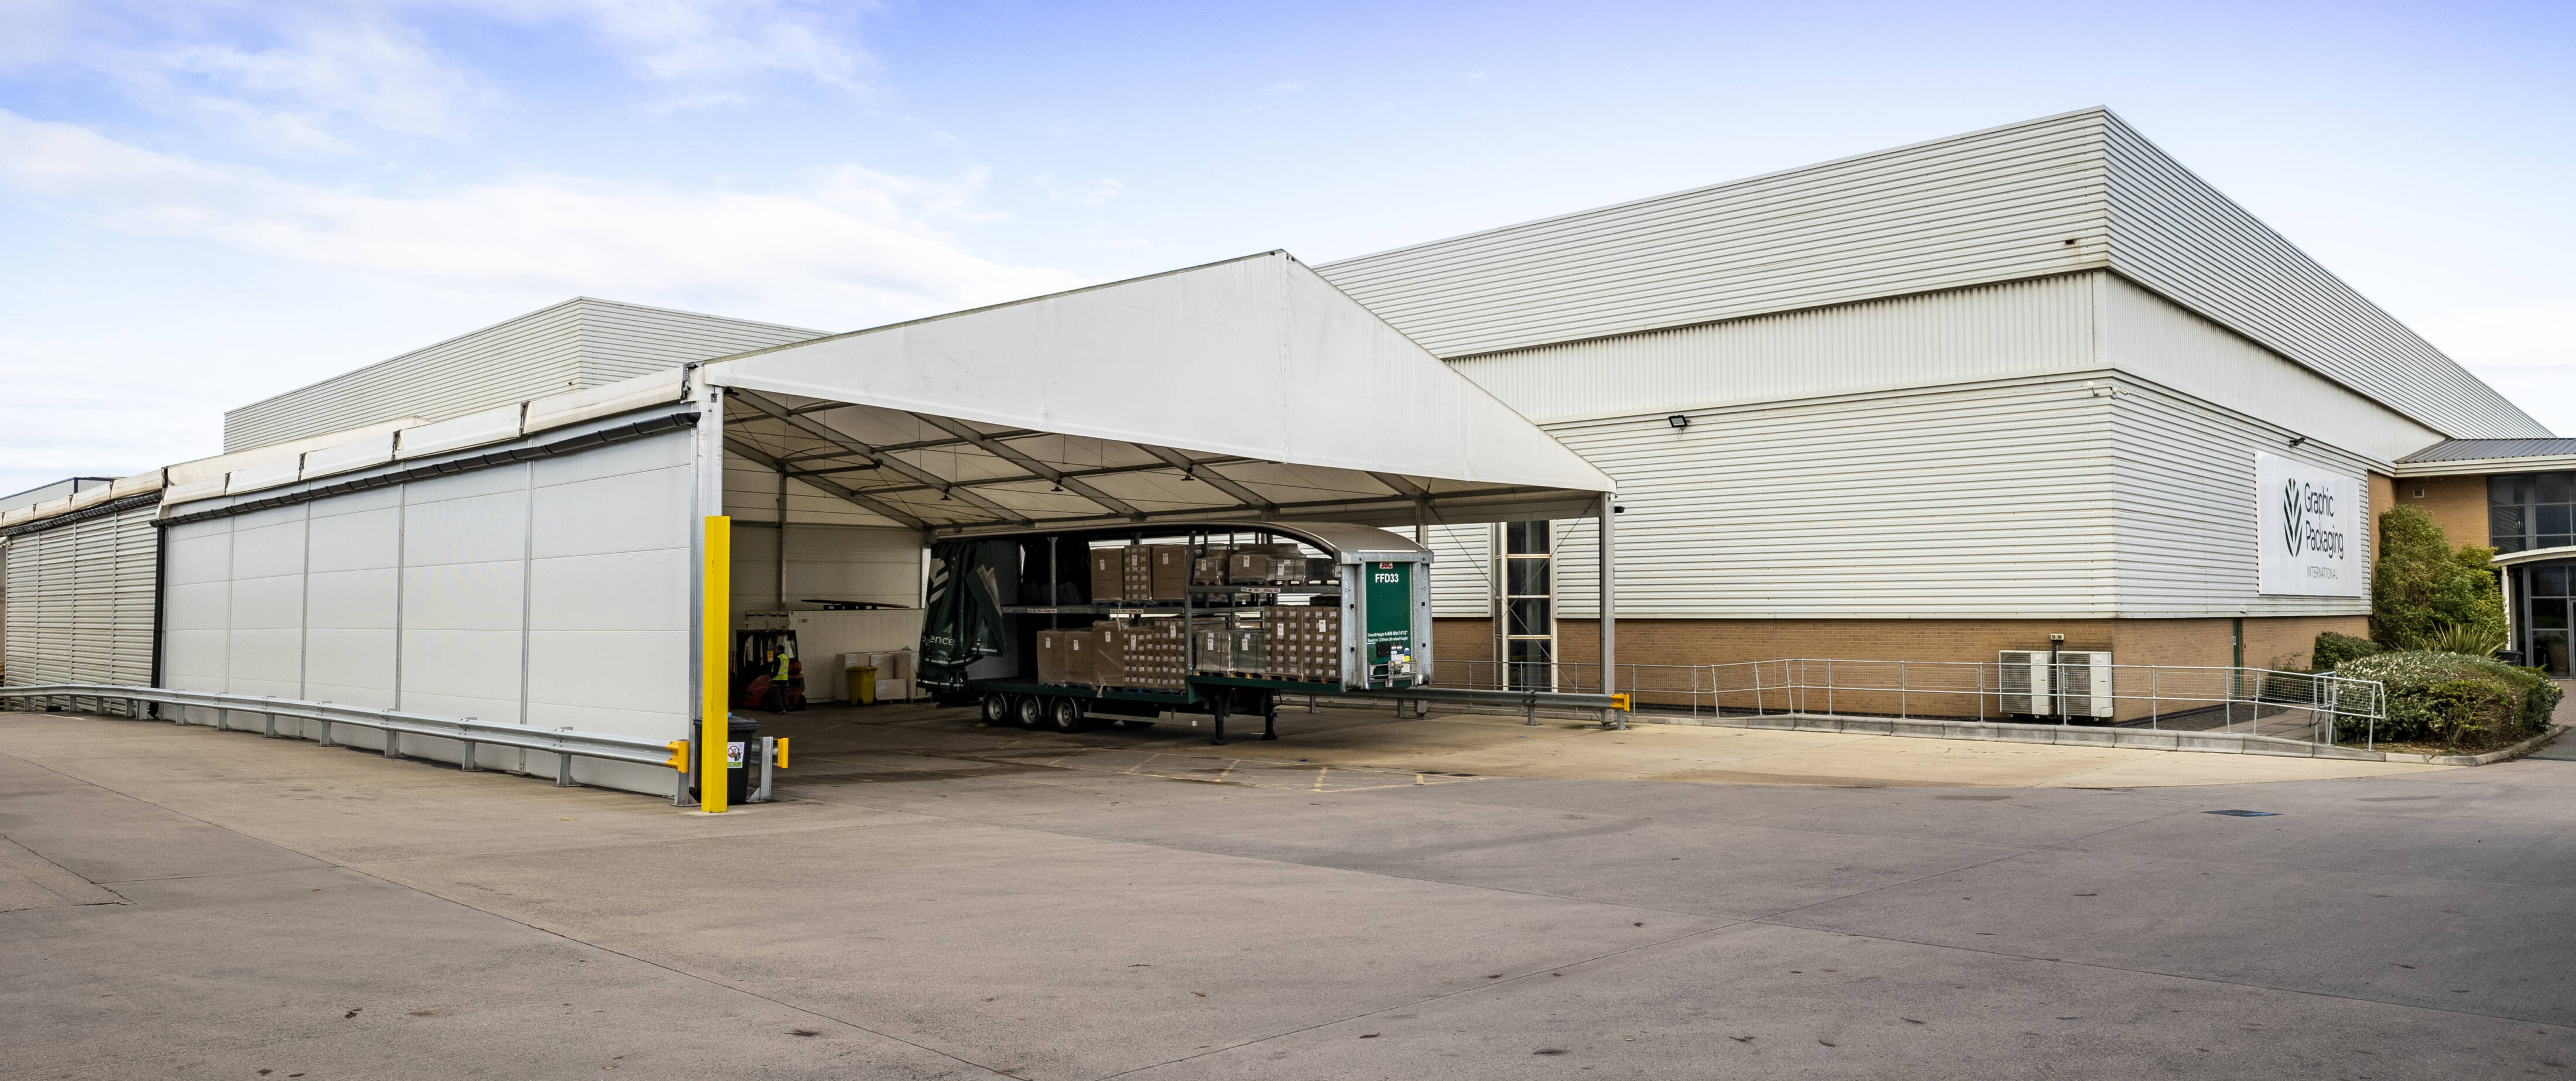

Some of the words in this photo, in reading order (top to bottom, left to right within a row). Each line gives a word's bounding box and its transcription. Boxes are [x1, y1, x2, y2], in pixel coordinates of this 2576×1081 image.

[2304, 482, 2334, 520] Graphic
[2306, 520, 2344, 560] Packaging
[1375, 573, 1399, 583] FFD33
[2307, 566, 2338, 580] INTERNATIONAL
